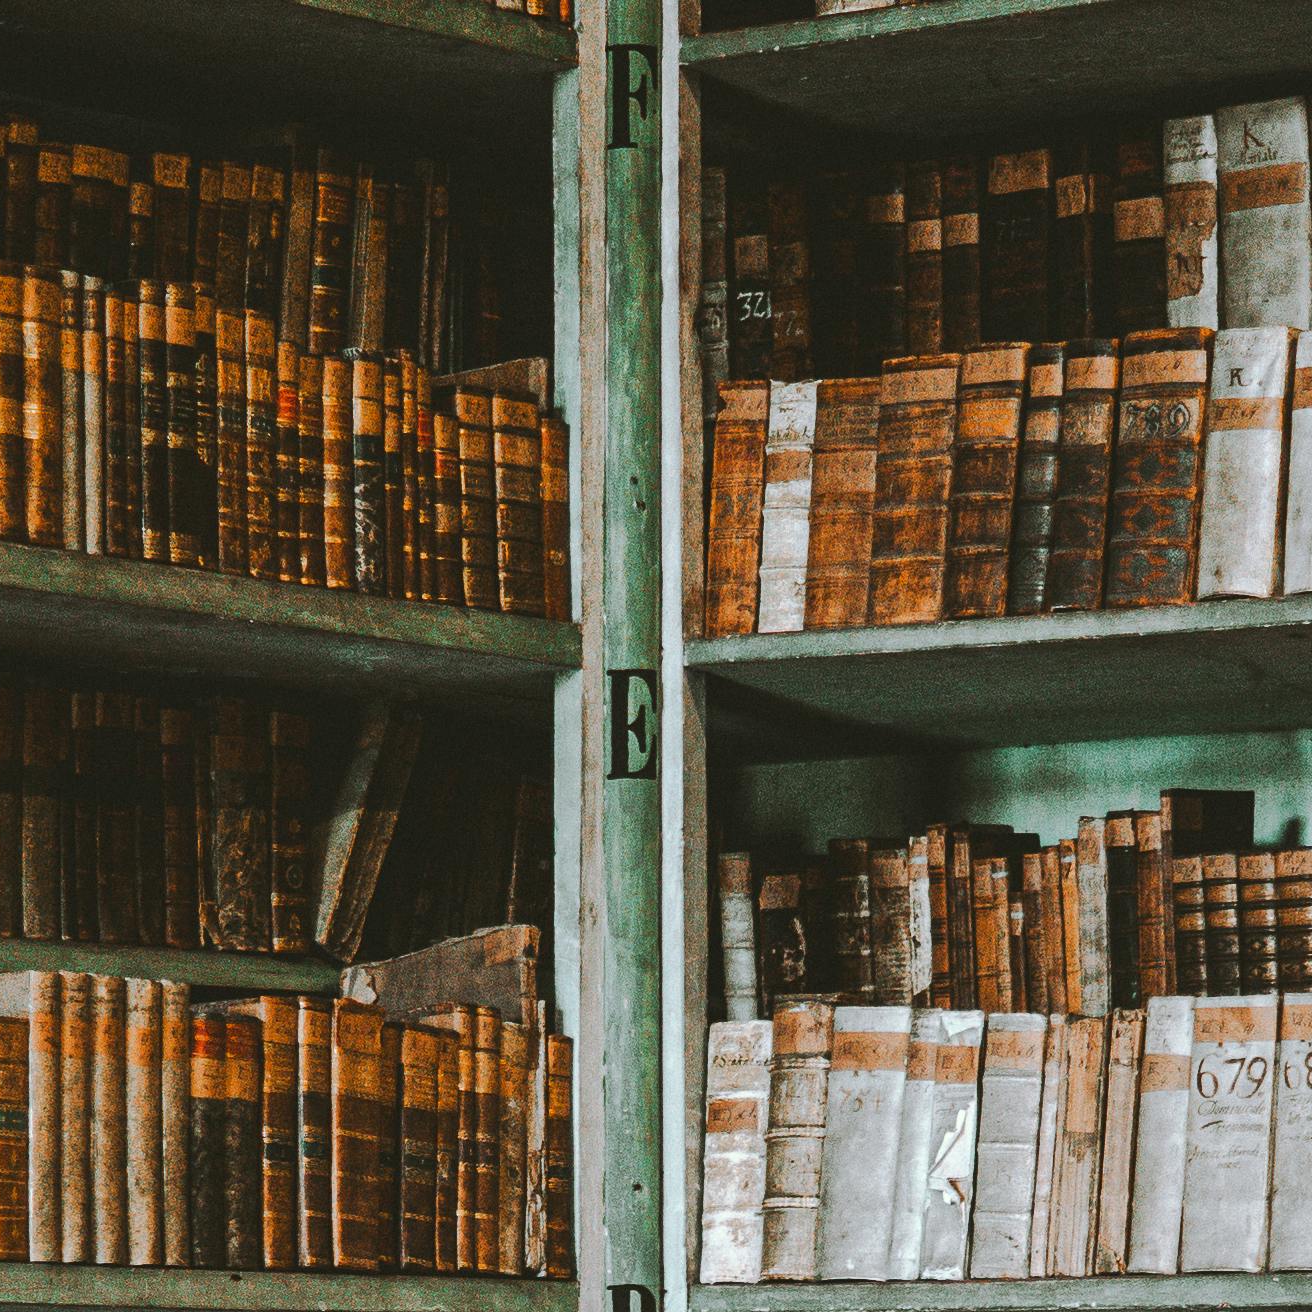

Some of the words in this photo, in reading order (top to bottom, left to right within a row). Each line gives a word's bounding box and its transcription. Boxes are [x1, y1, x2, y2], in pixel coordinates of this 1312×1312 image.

[607, 45, 658, 149] F
[1244, 121, 1266, 148] K
[736, 291, 771, 321] 321
[607, 669, 656, 779] E
